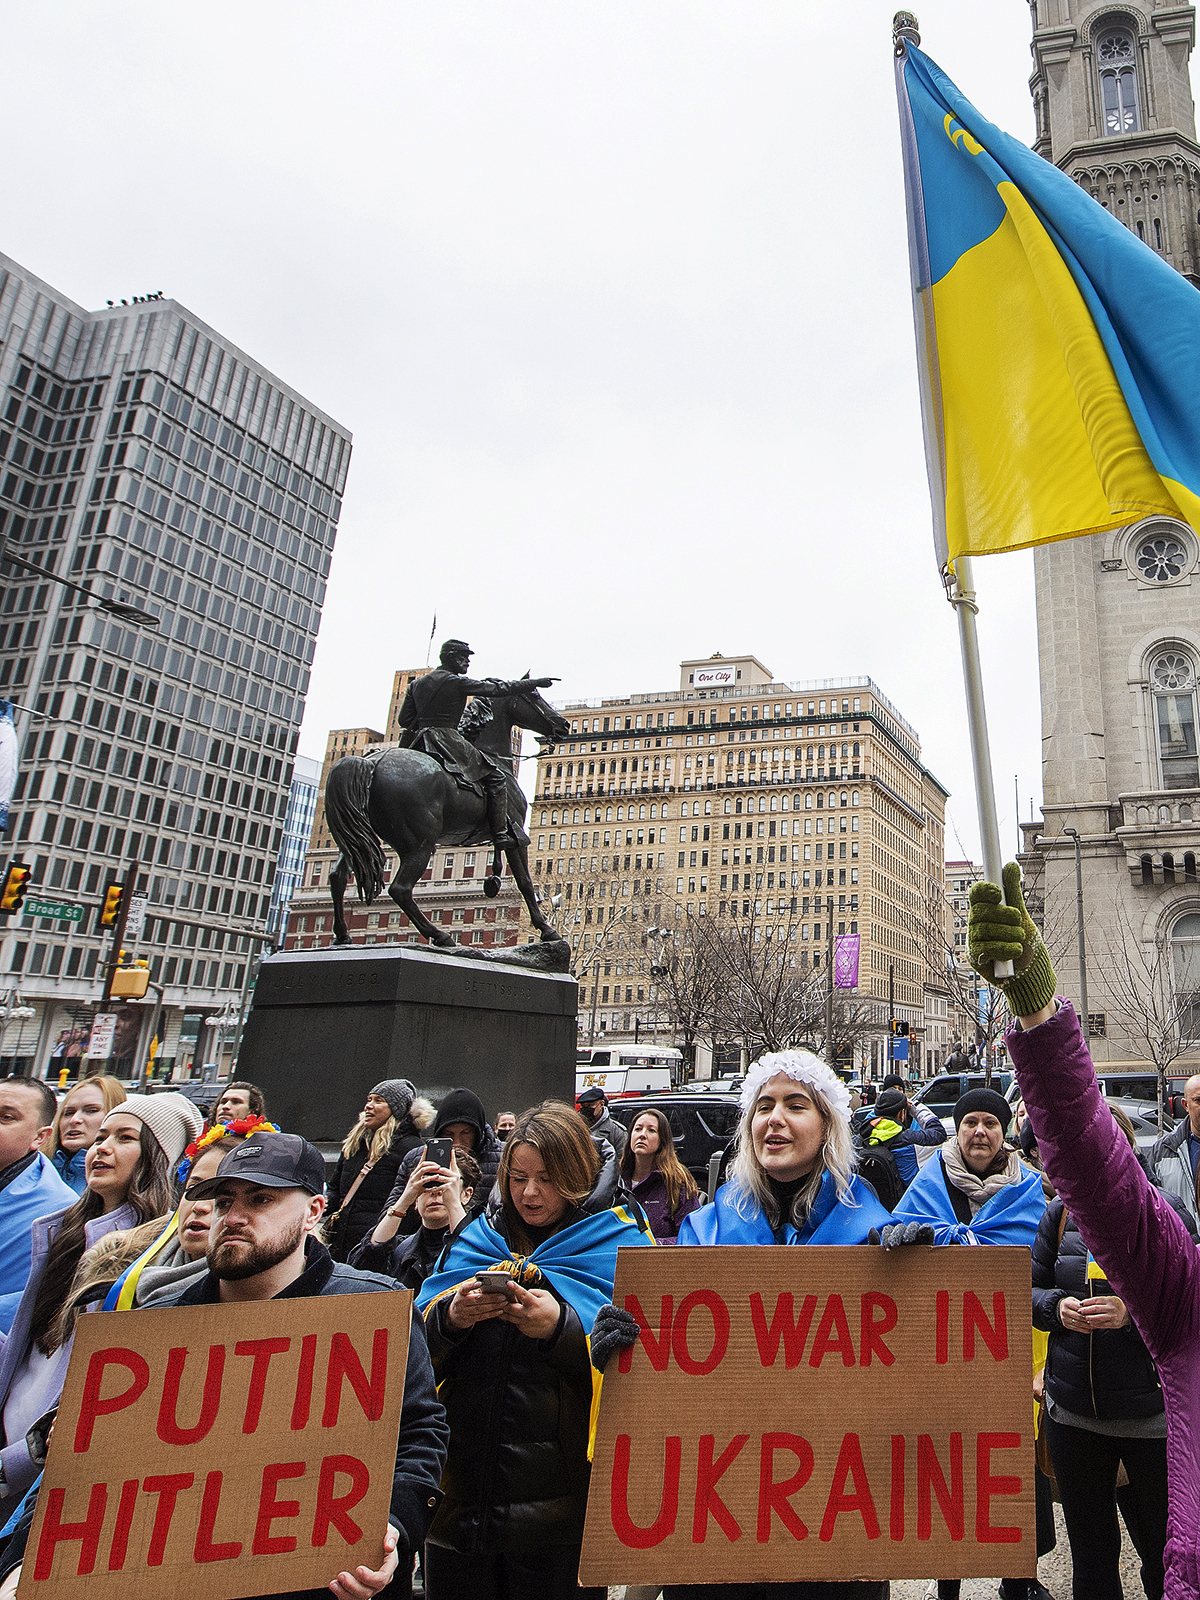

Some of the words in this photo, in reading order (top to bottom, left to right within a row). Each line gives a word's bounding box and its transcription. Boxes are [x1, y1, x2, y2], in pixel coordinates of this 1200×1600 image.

[699, 673, 713, 682] One
[715, 672, 731, 682] City
[28, 902, 60, 915] Broad
[66, 908, 78, 918] St
[618, 1289, 730, 1375] NO
[749, 1292, 898, 1370] WAR
[936, 1290, 1009, 1365] IN
[74, 1328, 388, 1453] PUTIN
[33, 1455, 369, 1581] HITLER
[611, 1432, 1022, 1549] UKRAINE
